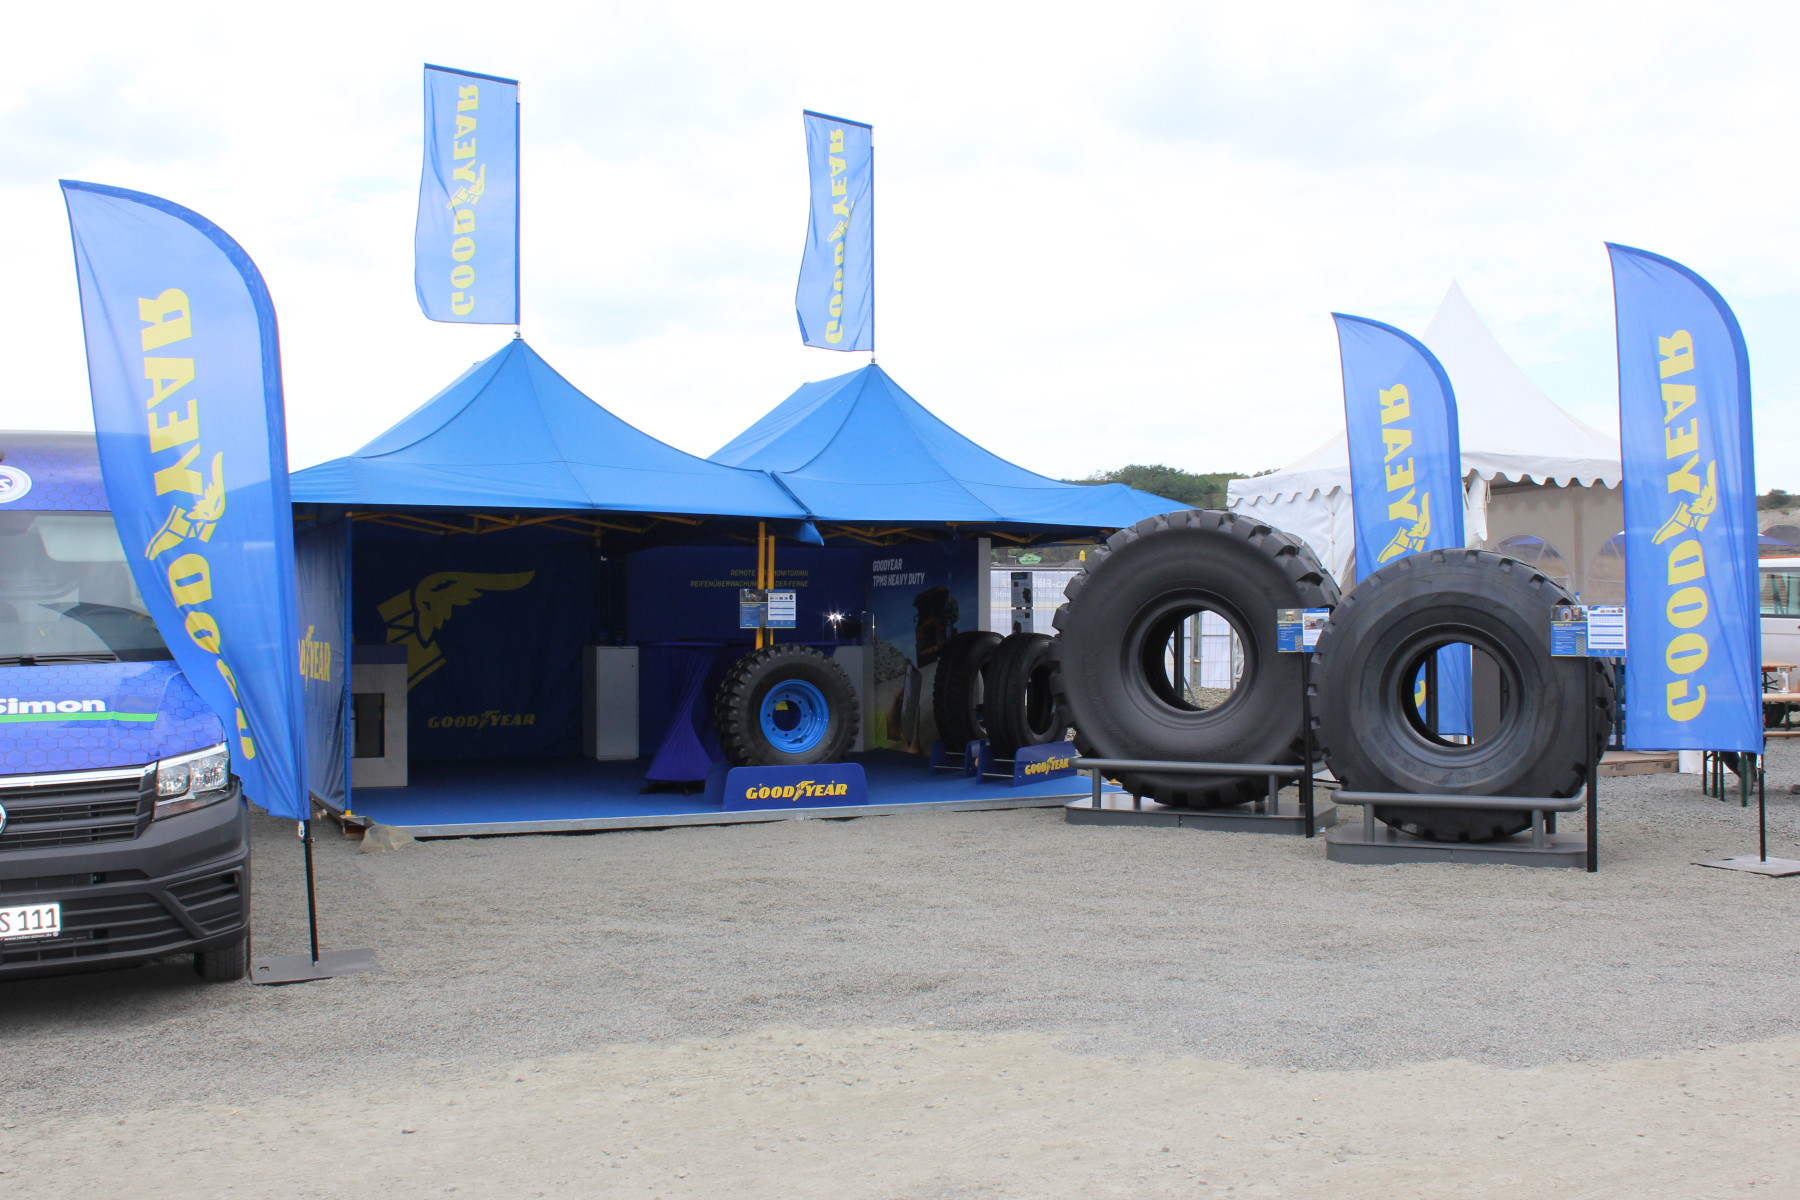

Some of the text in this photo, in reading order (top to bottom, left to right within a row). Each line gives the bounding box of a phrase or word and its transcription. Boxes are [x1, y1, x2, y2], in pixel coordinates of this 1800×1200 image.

[872, 558, 903, 572] GOODYEAR
[690, 578, 759, 587] REIFENÜBERWACHUN
[872, 572, 926, 587] TPMS HEAVY DUTY
[426, 710, 537, 730] GOODYEAR
[1024, 756, 1071, 776] GOODYEAR
[745, 782, 849, 801] GOODYEAR
[17, 907, 58, 932] 111
